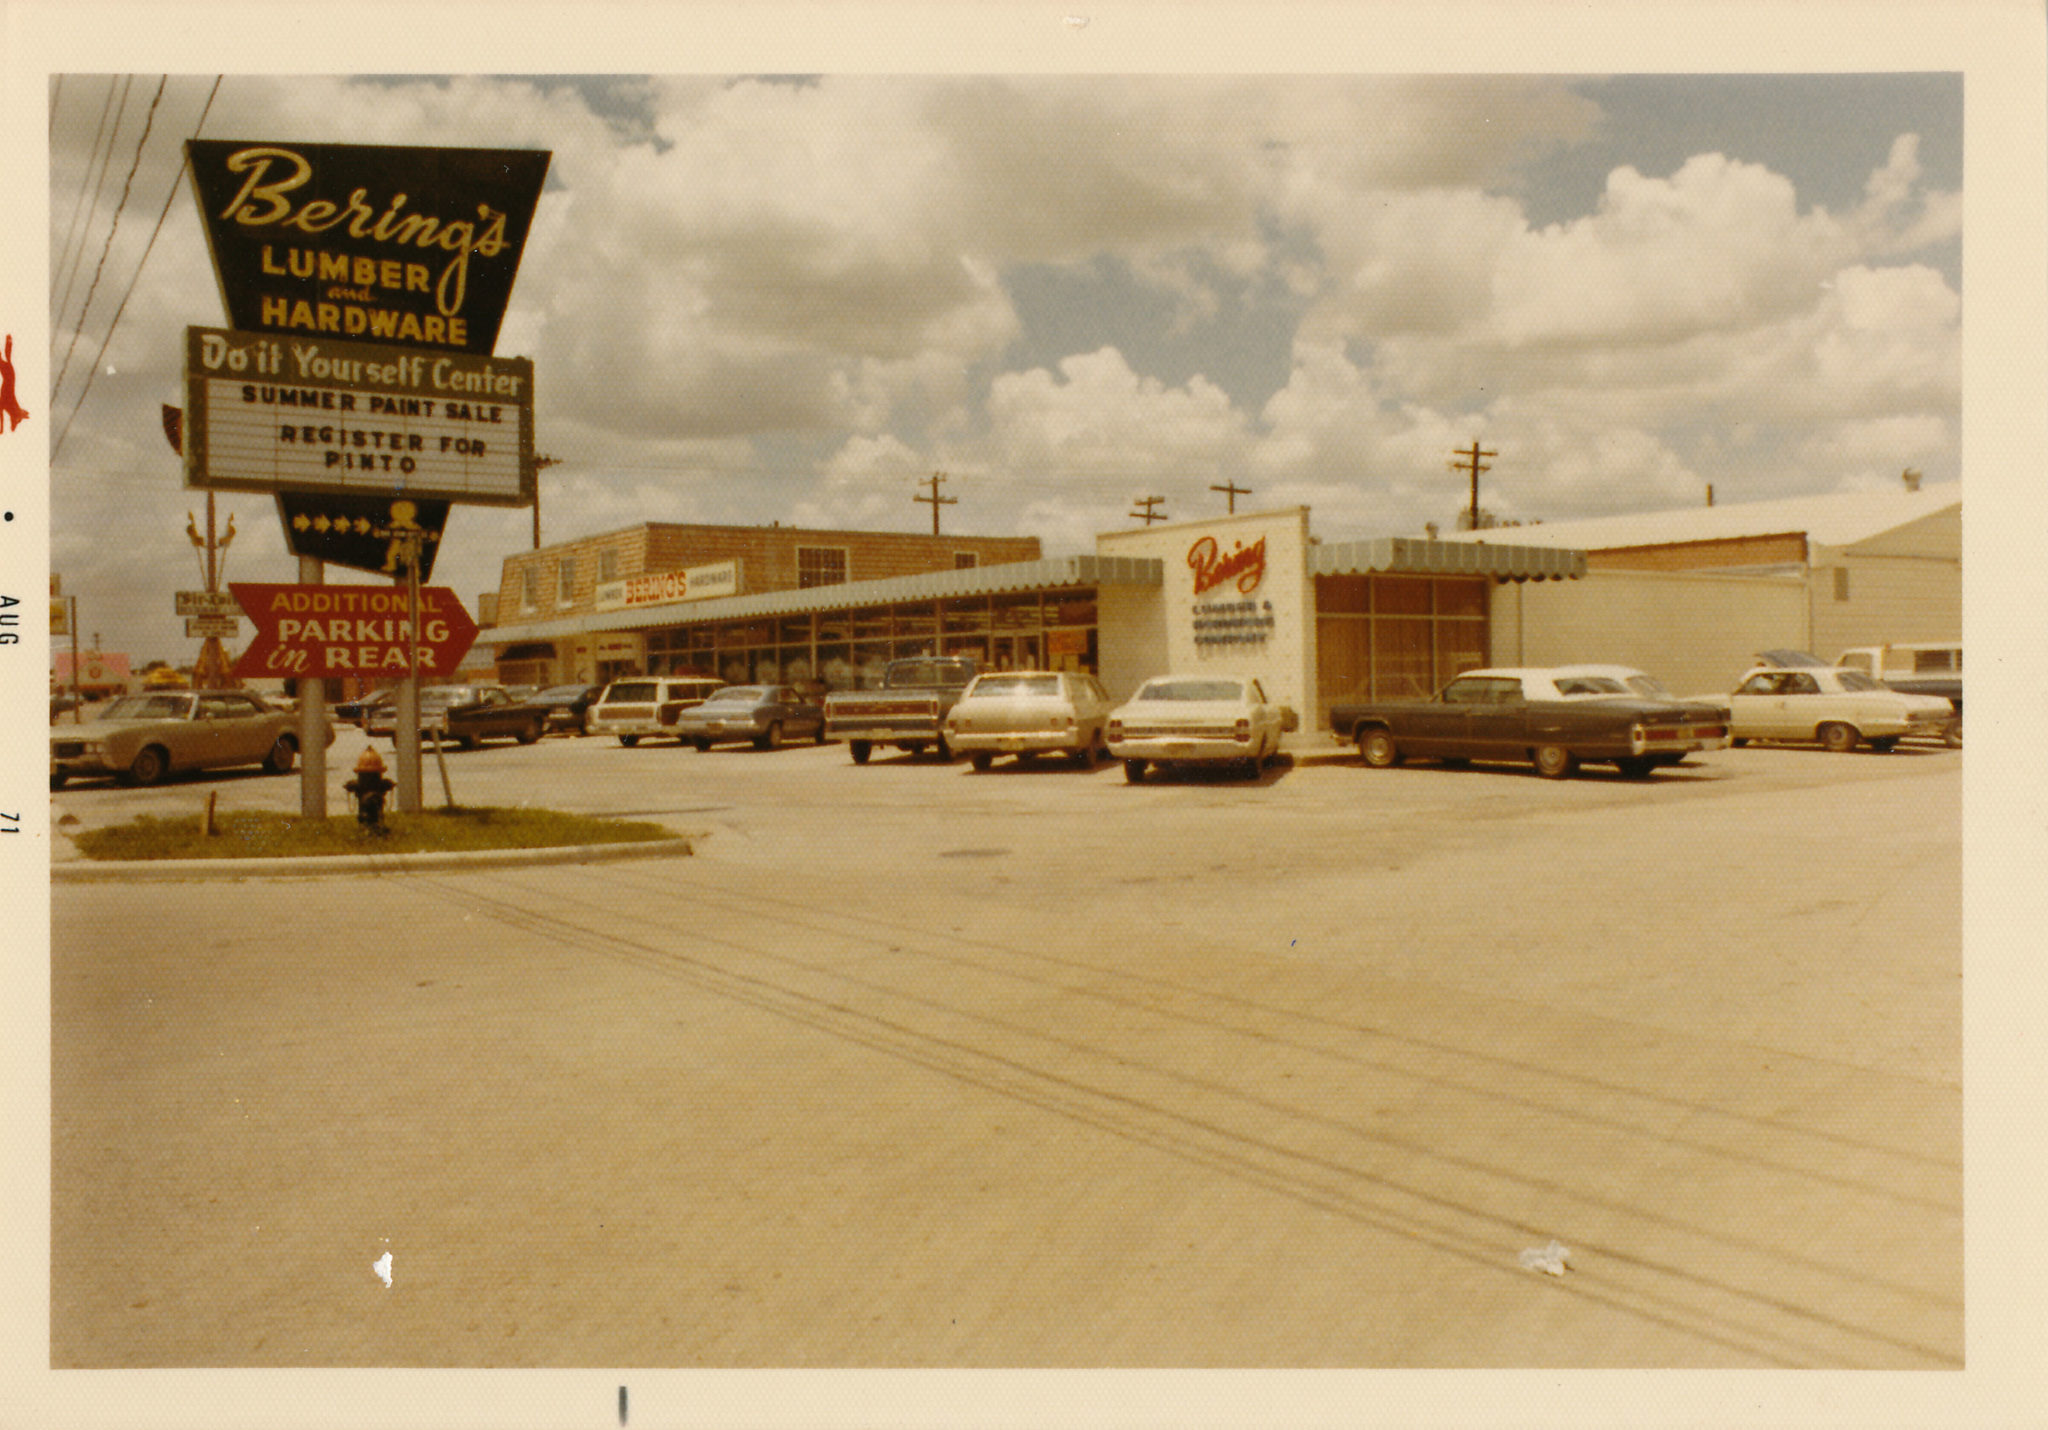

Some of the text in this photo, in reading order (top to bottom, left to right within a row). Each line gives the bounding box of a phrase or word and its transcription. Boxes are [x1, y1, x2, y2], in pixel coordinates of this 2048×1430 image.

[221, 147, 511, 316] Bering's
[262, 245, 430, 293] LUMBER
[327, 283, 372, 302] and
[262, 297, 467, 347] HARDWARE
[202, 334, 523, 397] Do it Yourself Center
[242, 385, 503, 424] SUMMER PAINT SALE
[281, 424, 486, 457] REGISTER FOR
[325, 451, 416, 473] PINTO
[278, 619, 450, 643] PARKING
[266, 643, 437, 673] in REAR
